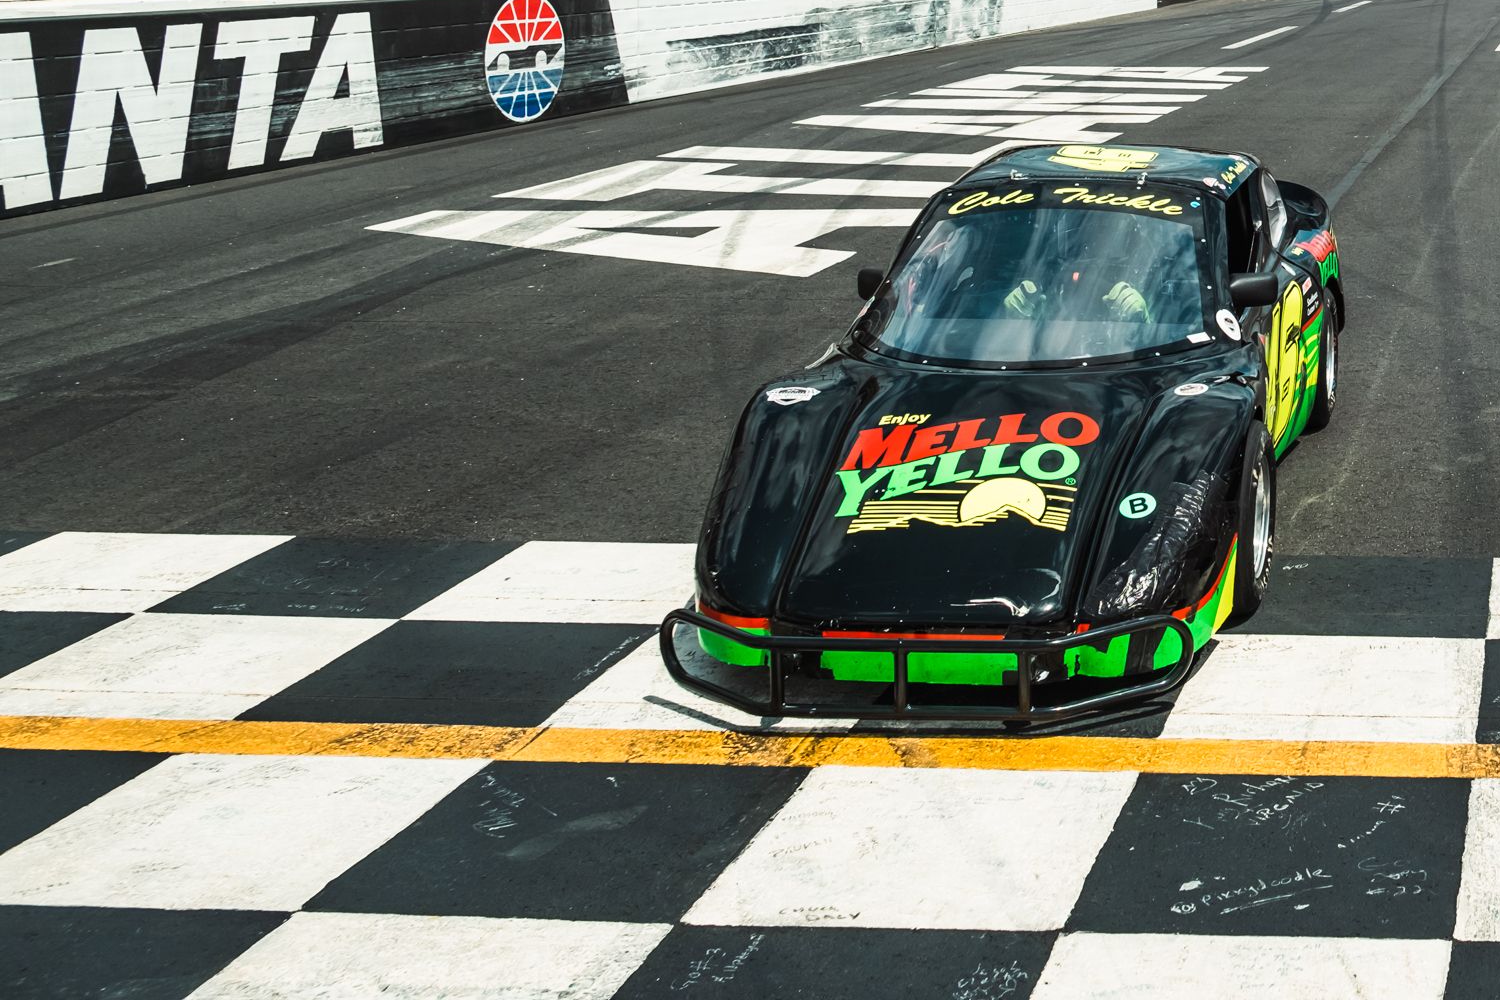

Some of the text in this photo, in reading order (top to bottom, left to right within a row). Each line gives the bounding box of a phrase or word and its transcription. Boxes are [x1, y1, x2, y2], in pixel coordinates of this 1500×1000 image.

[948, 187, 1183, 216] Cole Trickle
[878, 413, 932, 427] Enjoy
[841, 411, 1101, 471] MELLO
[834, 442, 1081, 518] YELLO
[1129, 496, 1149, 515] B
